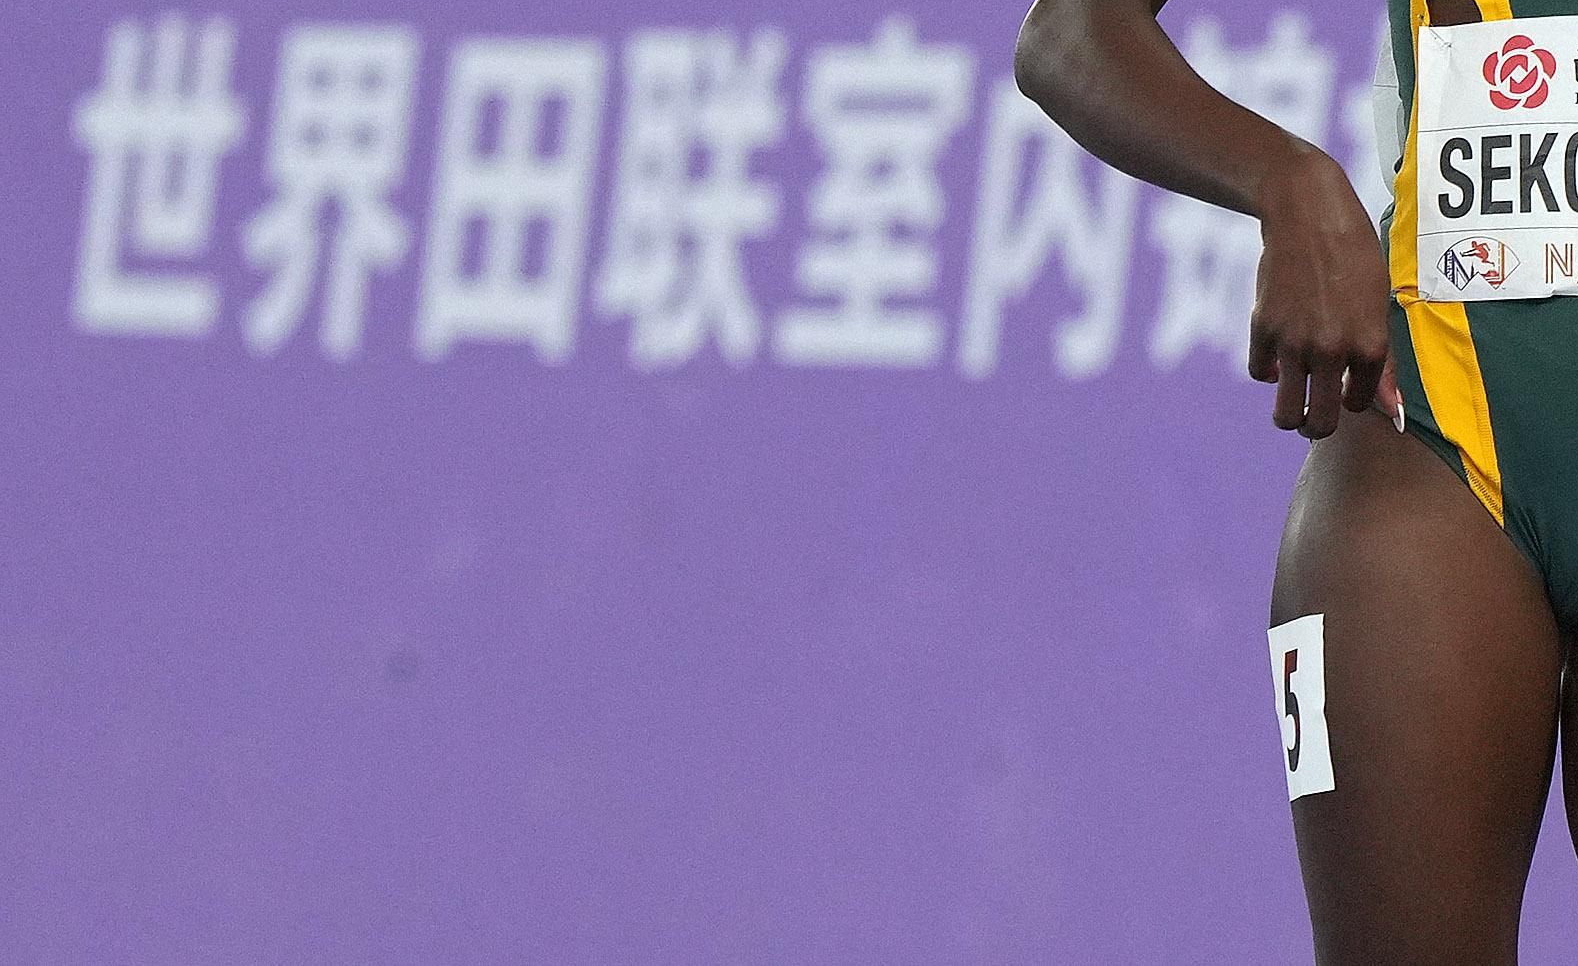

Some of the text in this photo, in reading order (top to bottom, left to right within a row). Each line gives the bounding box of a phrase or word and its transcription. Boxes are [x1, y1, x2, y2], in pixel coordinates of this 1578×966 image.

[70, 12, 1392, 380] 世界田联室内
[1284, 648, 1301, 772] 5
